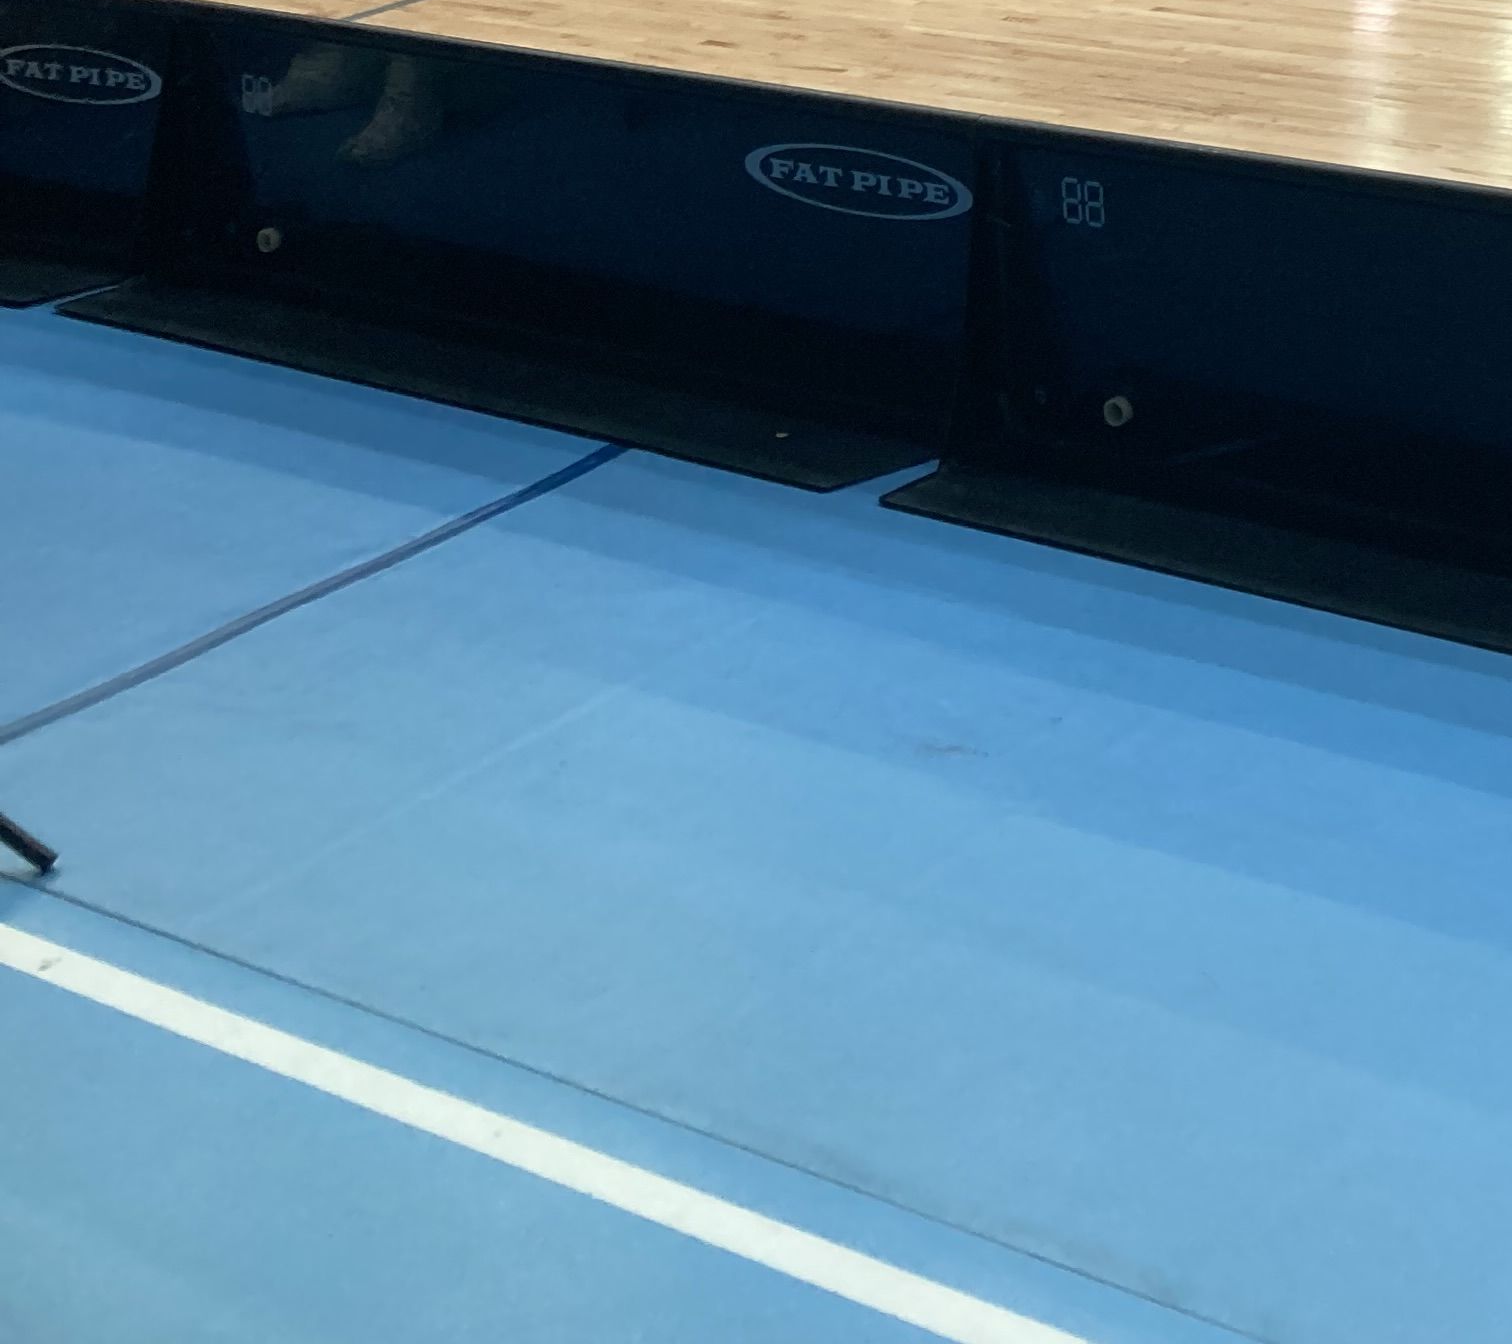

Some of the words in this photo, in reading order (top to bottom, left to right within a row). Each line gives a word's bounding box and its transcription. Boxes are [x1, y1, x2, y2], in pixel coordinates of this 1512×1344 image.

[5, 59, 64, 80] FAT
[69, 65, 146, 91] PIPE
[768, 158, 843, 188] FAT
[850, 170, 950, 205] PIPE
